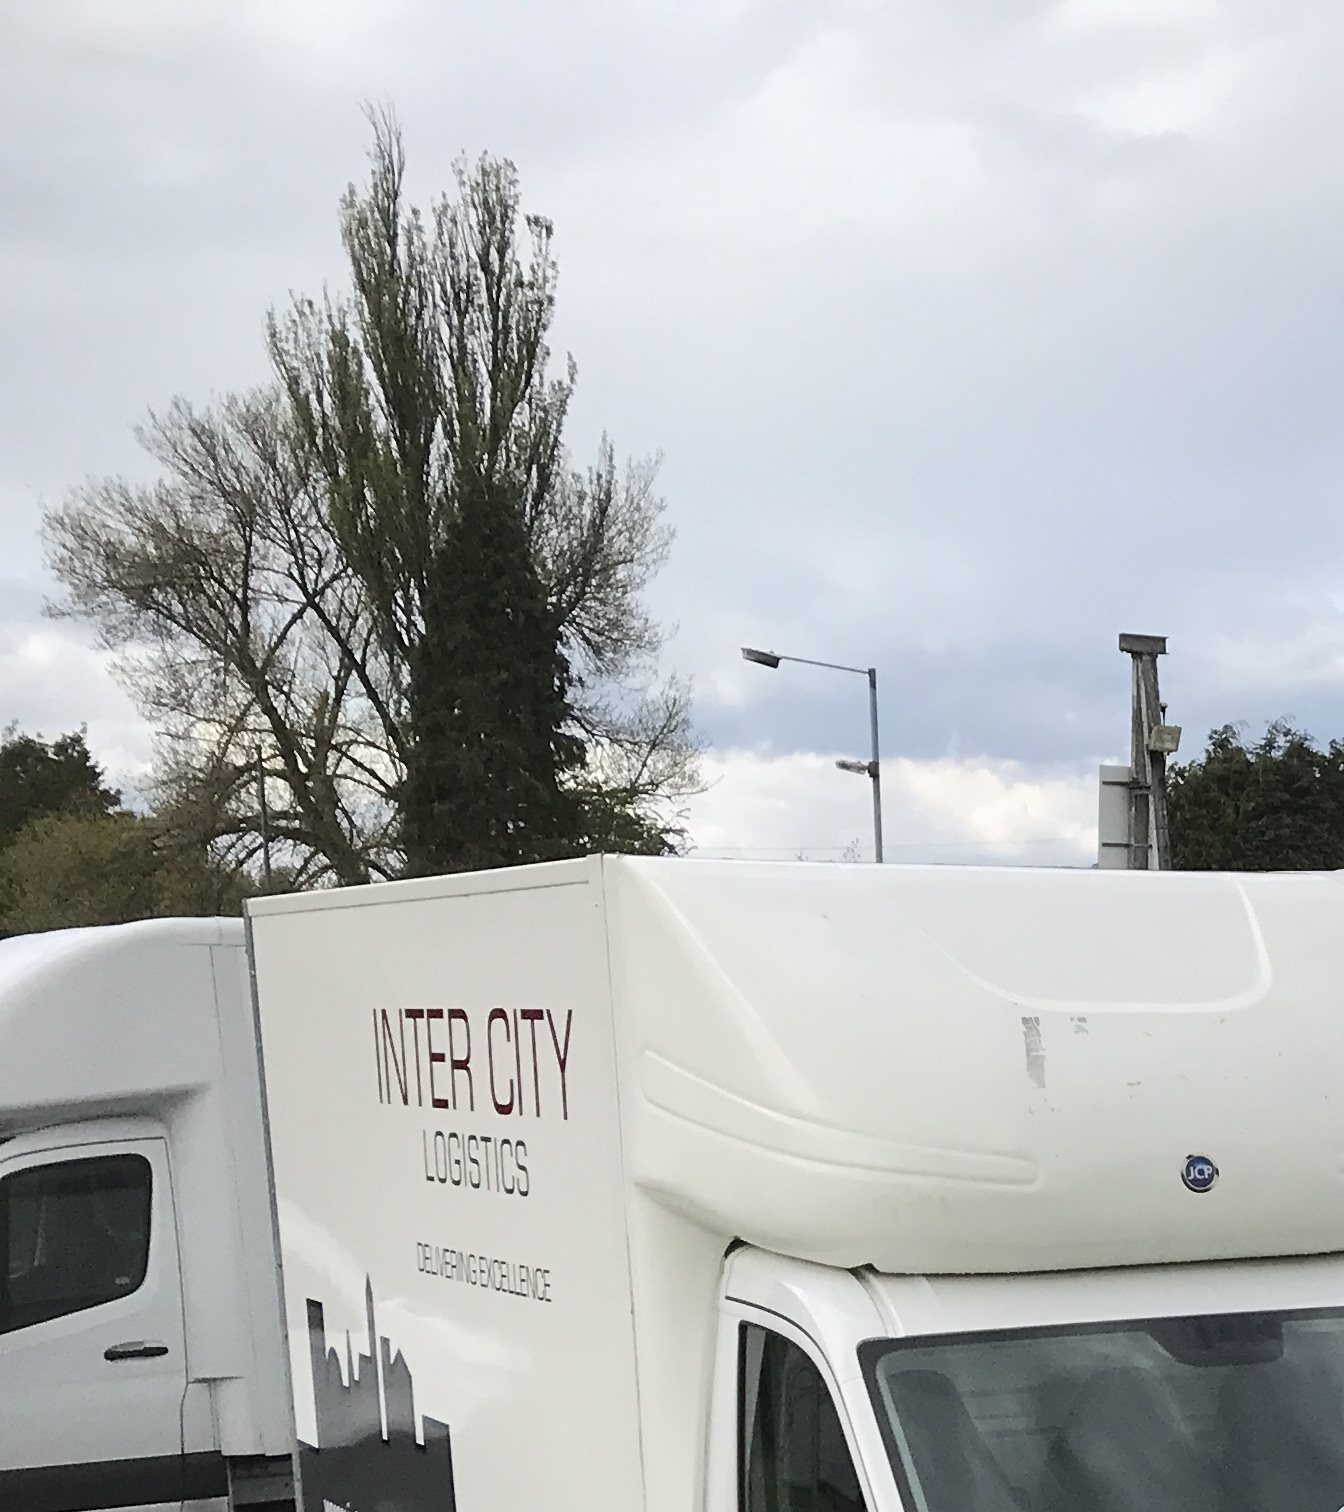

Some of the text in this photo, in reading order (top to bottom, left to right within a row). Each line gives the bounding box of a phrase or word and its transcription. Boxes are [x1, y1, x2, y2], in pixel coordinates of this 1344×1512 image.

[372, 1007, 573, 1121] INTER CITY
[422, 1129, 531, 1198] LOGISTICS
[1188, 1164, 1213, 1180] JCP
[415, 1242, 553, 1303] DELIVERING EXCELLENCE
